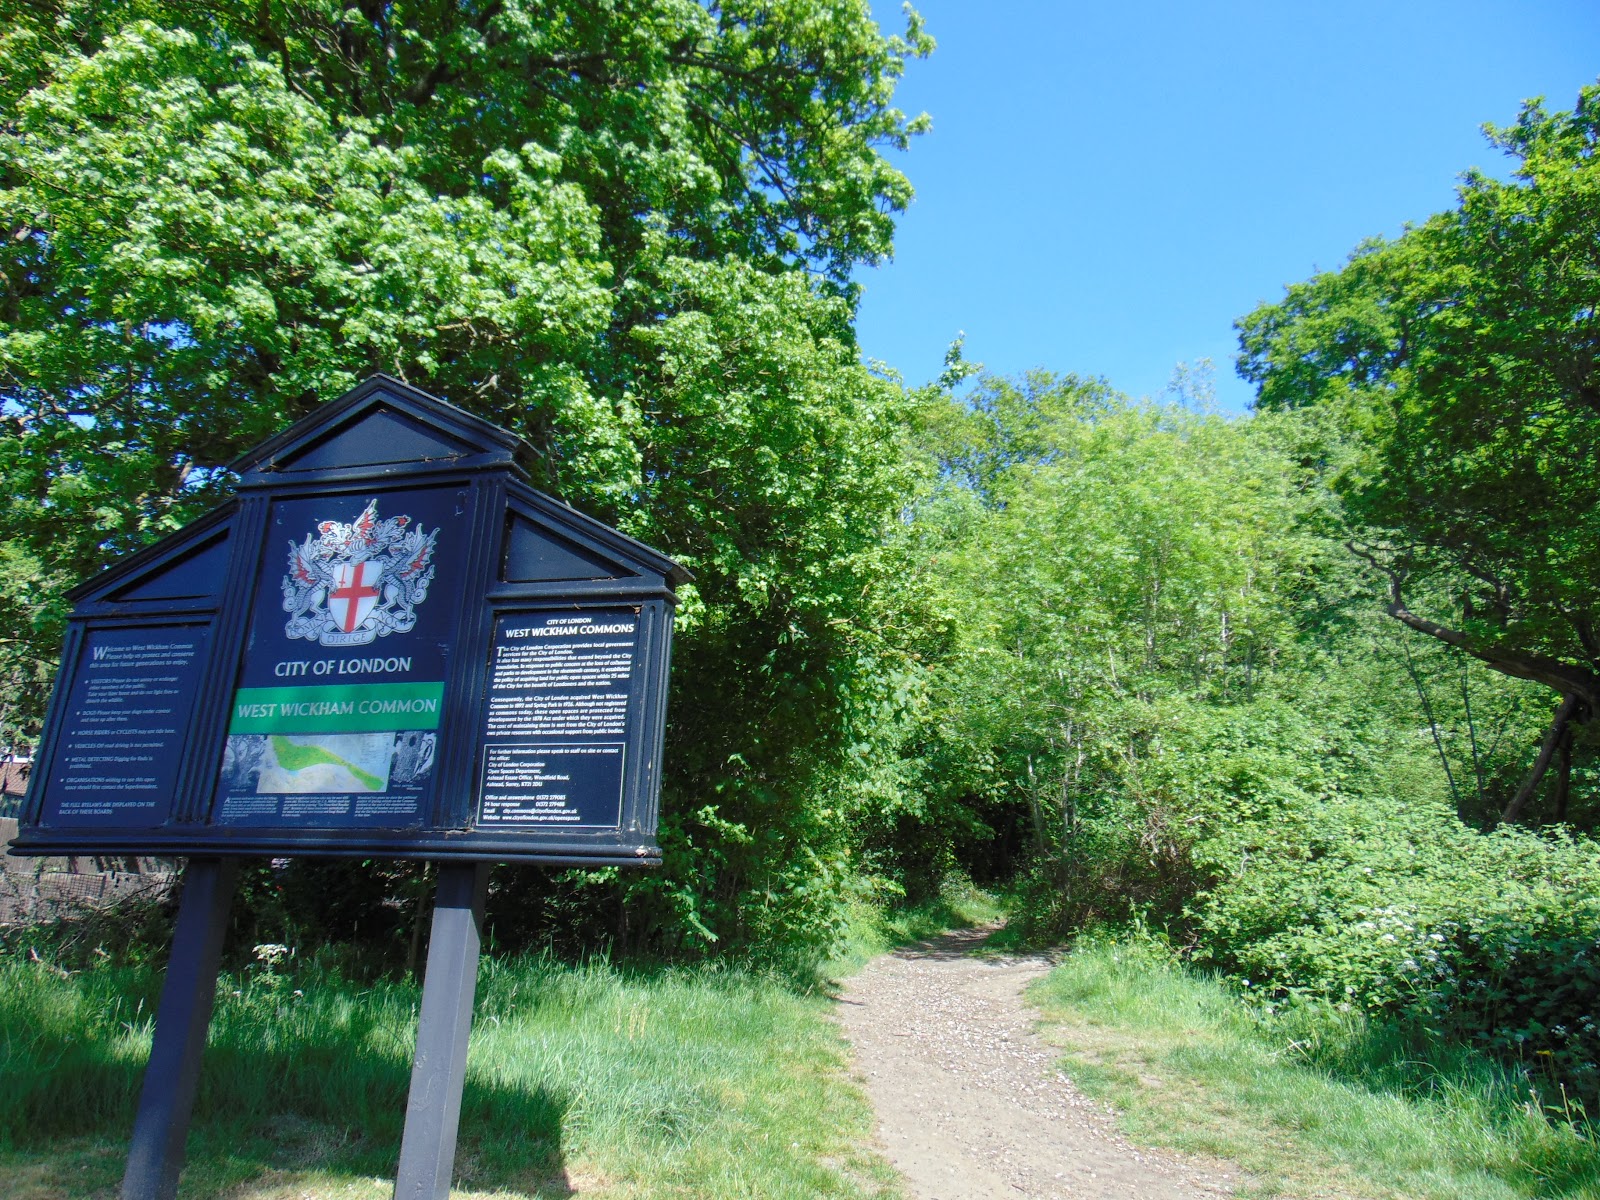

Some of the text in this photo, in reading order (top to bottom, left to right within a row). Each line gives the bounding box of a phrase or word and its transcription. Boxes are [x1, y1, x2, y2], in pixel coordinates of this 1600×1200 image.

[327, 632, 367, 644] DIRIGE
[505, 623, 634, 638] WEST WICKHAM COMMONS
[496, 646, 509, 656] The
[543, 643, 571, 651] Corporation
[605, 640, 633, 648] government
[532, 655, 566, 663] responsibilities
[274, 657, 412, 677] CITY OF LONDON
[238, 699, 437, 718] WEST WICKHAM COMMON
